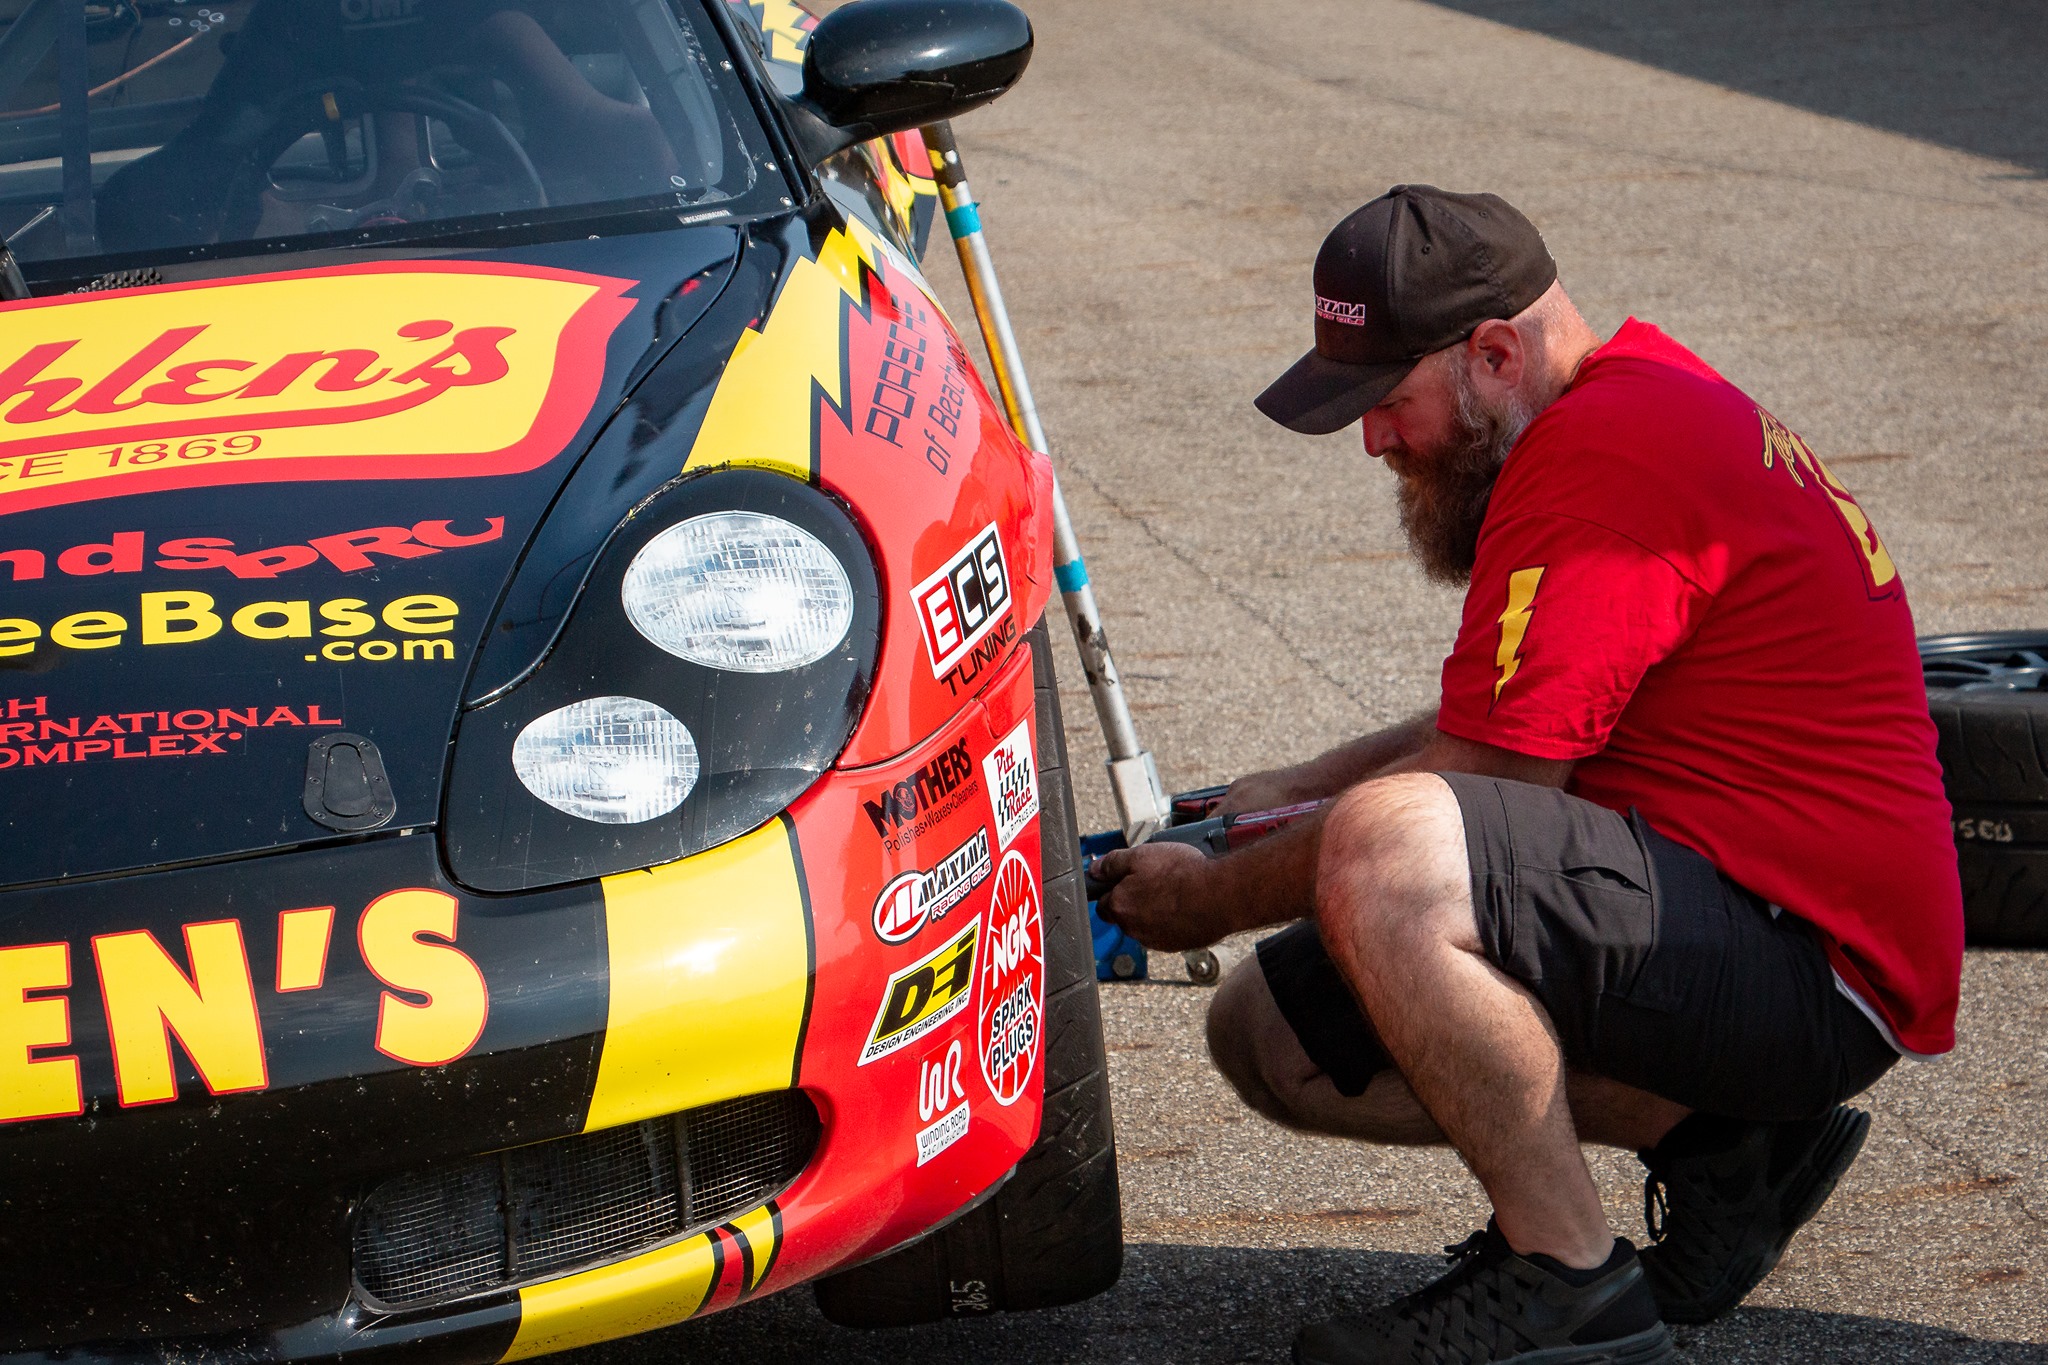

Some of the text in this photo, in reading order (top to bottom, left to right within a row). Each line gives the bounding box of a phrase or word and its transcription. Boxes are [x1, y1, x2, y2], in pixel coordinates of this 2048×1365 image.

[865, 293, 927, 448] PORSCHE
[98, 435, 262, 470] 1869
[923, 428, 951, 476] of
[922, 535, 1005, 660] ECS
[304, 637, 455, 662] .com
[941, 613, 1017, 697] TUNING
[863, 737, 972, 839] MOTHERS
[993, 744, 1016, 781] Pitt
[1005, 786, 1032, 821] Race
[918, 831, 988, 908] MAXIMA
[971, 861, 991, 886] OILS
[992, 896, 1032, 989] NGK
[0, 887, 489, 1123] EN'S
[865, 1033, 903, 1059] DESIGN
[903, 1002, 954, 1041] ENGINEERING
[991, 973, 1034, 1041] SPARK
[991, 1010, 1034, 1081] PLUGS
[920, 1106, 967, 1149] WINDING ROAD
[921, 1122, 967, 1160] RACING.COM
